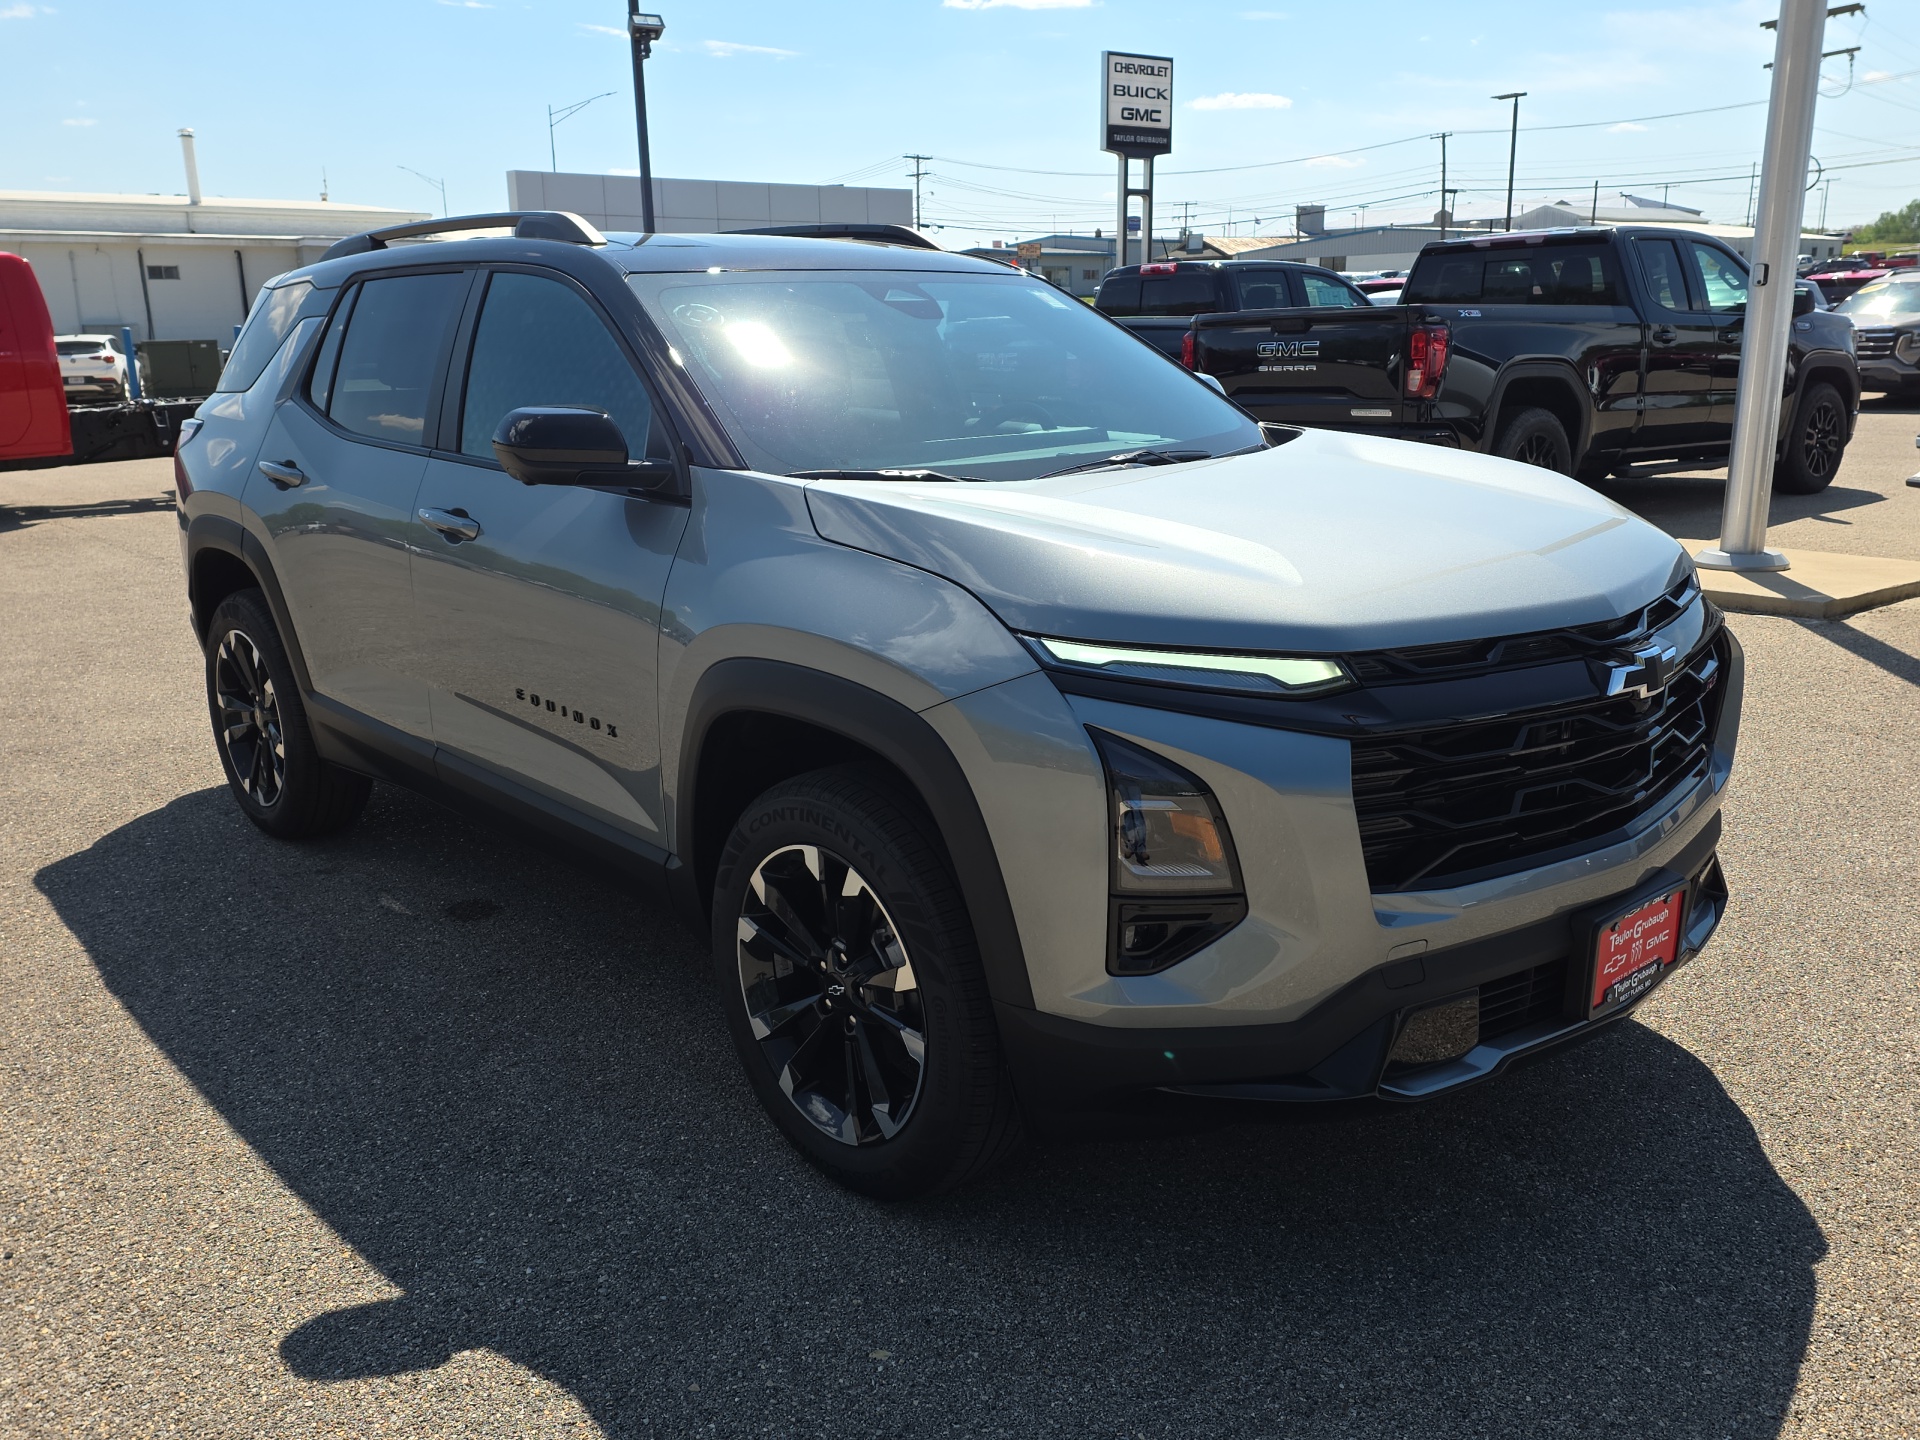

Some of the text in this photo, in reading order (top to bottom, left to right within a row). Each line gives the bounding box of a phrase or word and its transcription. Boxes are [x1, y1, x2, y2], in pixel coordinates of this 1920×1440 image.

[1114, 62, 1169, 78] CHEVROLET
[1113, 84, 1169, 101] BUICK
[1121, 106, 1162, 123] GMC
[1113, 134, 1168, 144] TAYLOR GRUBAUGH
[1256, 340, 1320, 357] GMC
[1258, 364, 1317, 372] SIERRA
[515, 688, 618, 738] EQUINOX
[749, 806, 889, 887] CONTINENTAL
[1609, 907, 1669, 953] Taylor Grubaugh
[1646, 929, 1670, 950] GMC
